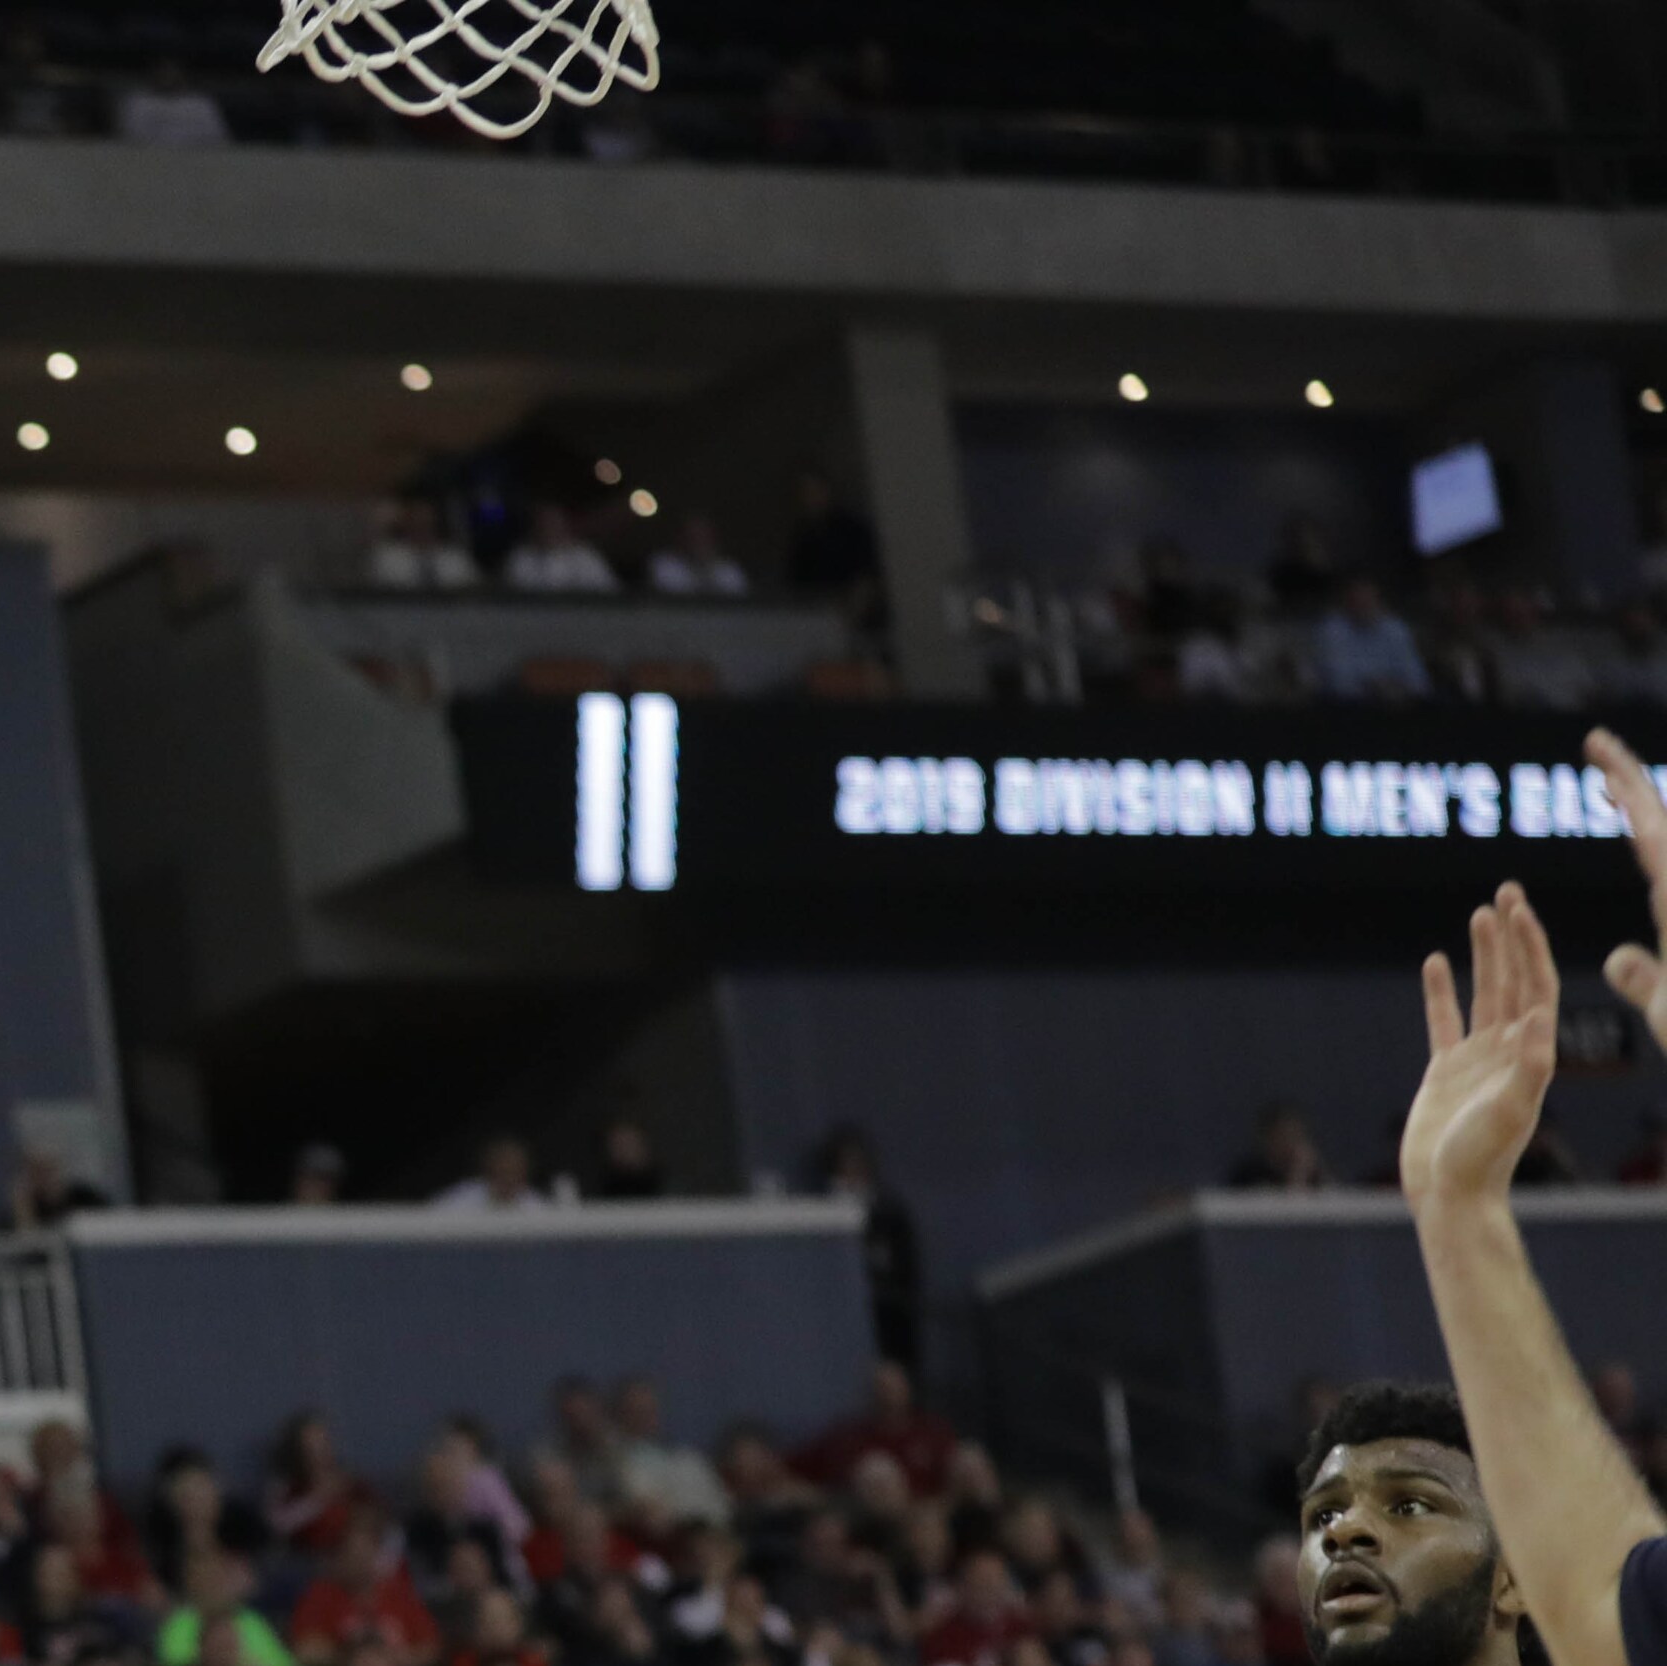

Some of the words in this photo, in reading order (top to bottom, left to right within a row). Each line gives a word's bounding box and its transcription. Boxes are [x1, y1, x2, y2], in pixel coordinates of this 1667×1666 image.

[993, 756, 1256, 837] DIVISION
[1263, 759, 1314, 838] II
[1320, 760, 1502, 839] MEN'S
